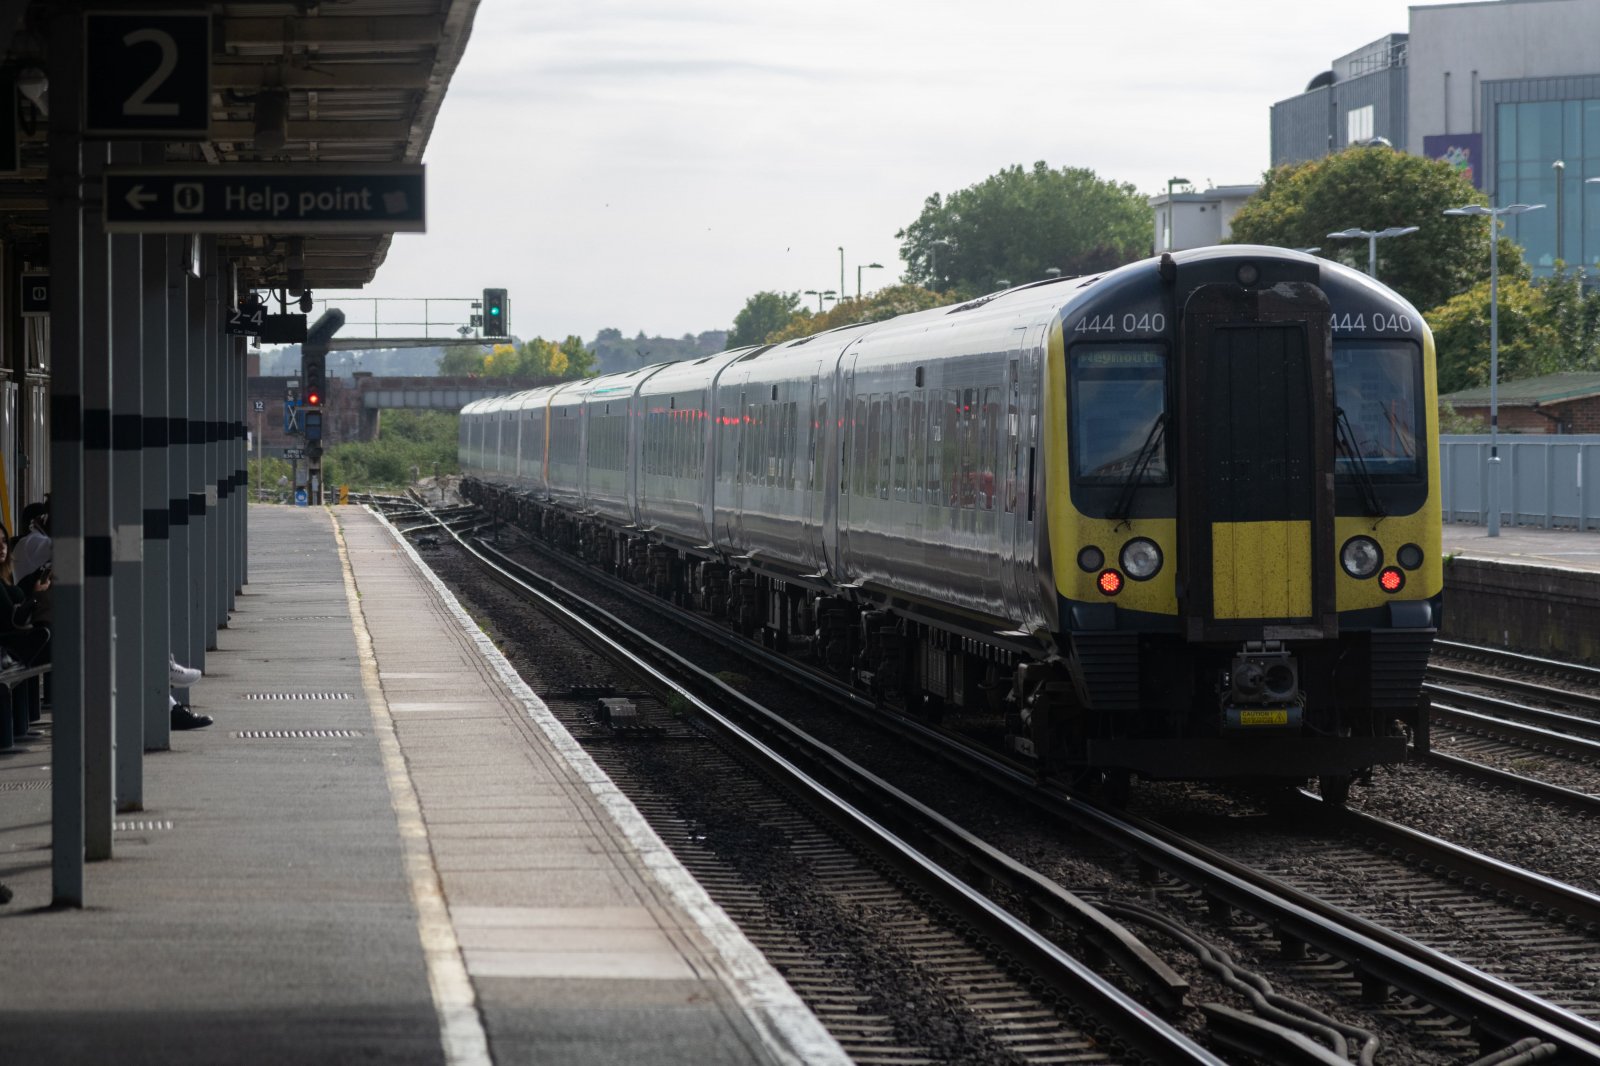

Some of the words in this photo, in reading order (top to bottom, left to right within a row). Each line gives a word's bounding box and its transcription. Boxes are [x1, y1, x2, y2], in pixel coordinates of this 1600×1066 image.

[122, 28, 180, 117] 2
[225, 186, 290, 216] Help
[300, 186, 372, 216] point
[230, 309, 263, 326] 2-4
[1075, 313, 1116, 333] 444
[1123, 313, 1165, 333] 040
[1329, 313, 1367, 333] 444
[1372, 313, 1411, 333] 040
